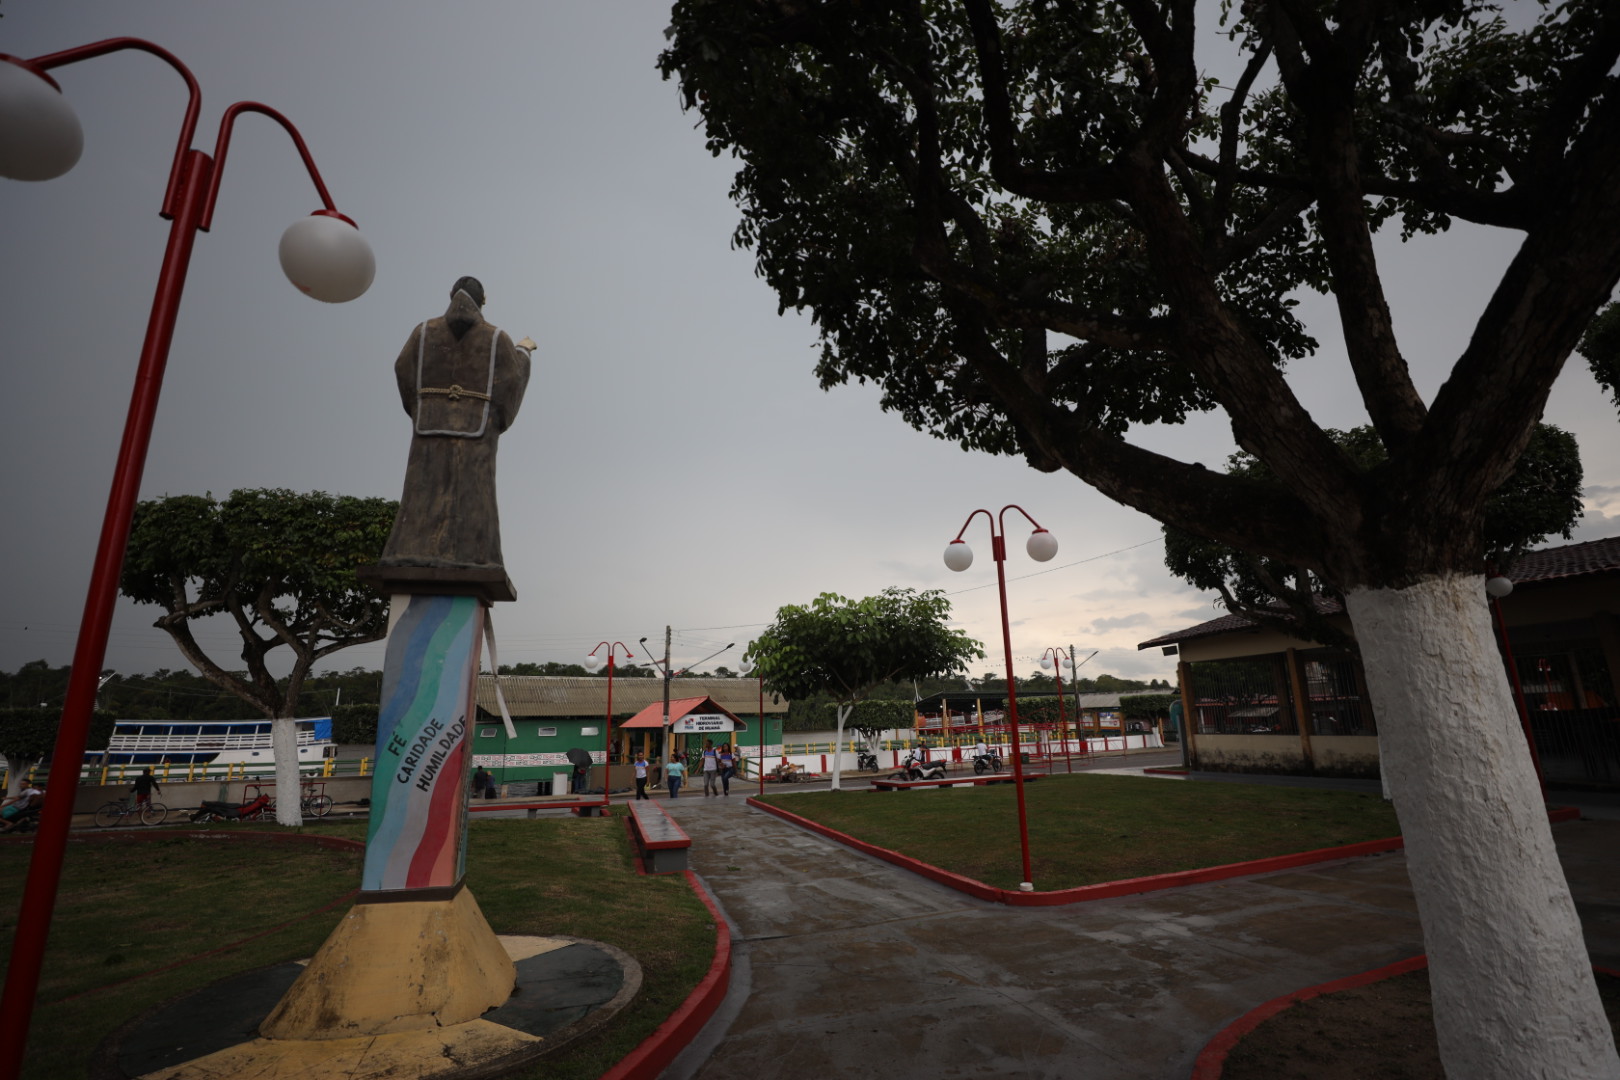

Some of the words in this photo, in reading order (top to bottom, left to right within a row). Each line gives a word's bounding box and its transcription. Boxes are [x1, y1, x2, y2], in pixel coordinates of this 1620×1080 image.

[387, 731, 407, 756] FÉ
[397, 718, 445, 783] CARIDADE
[416, 715, 466, 792] HUMILDADE
